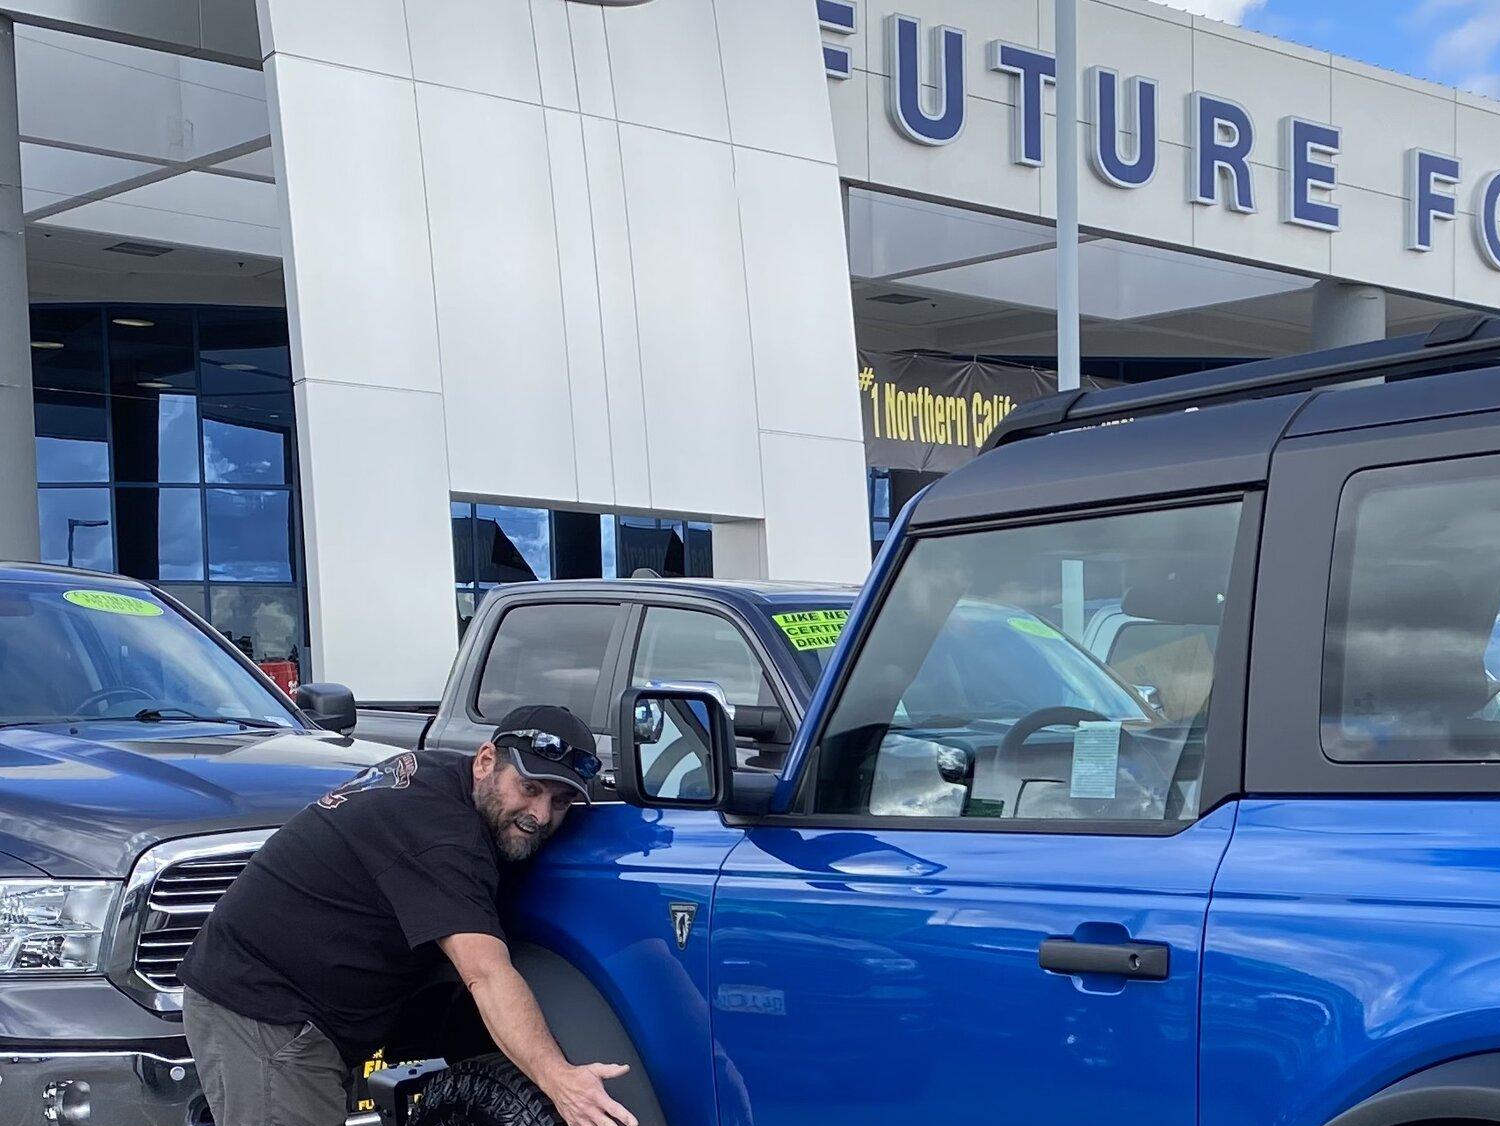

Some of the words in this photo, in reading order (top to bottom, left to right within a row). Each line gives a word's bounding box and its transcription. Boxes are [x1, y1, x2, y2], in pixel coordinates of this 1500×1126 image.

[859, 366, 881, 438] #1
[885, 382, 968, 447] Northern
[782, 612, 821, 624] LIKE
